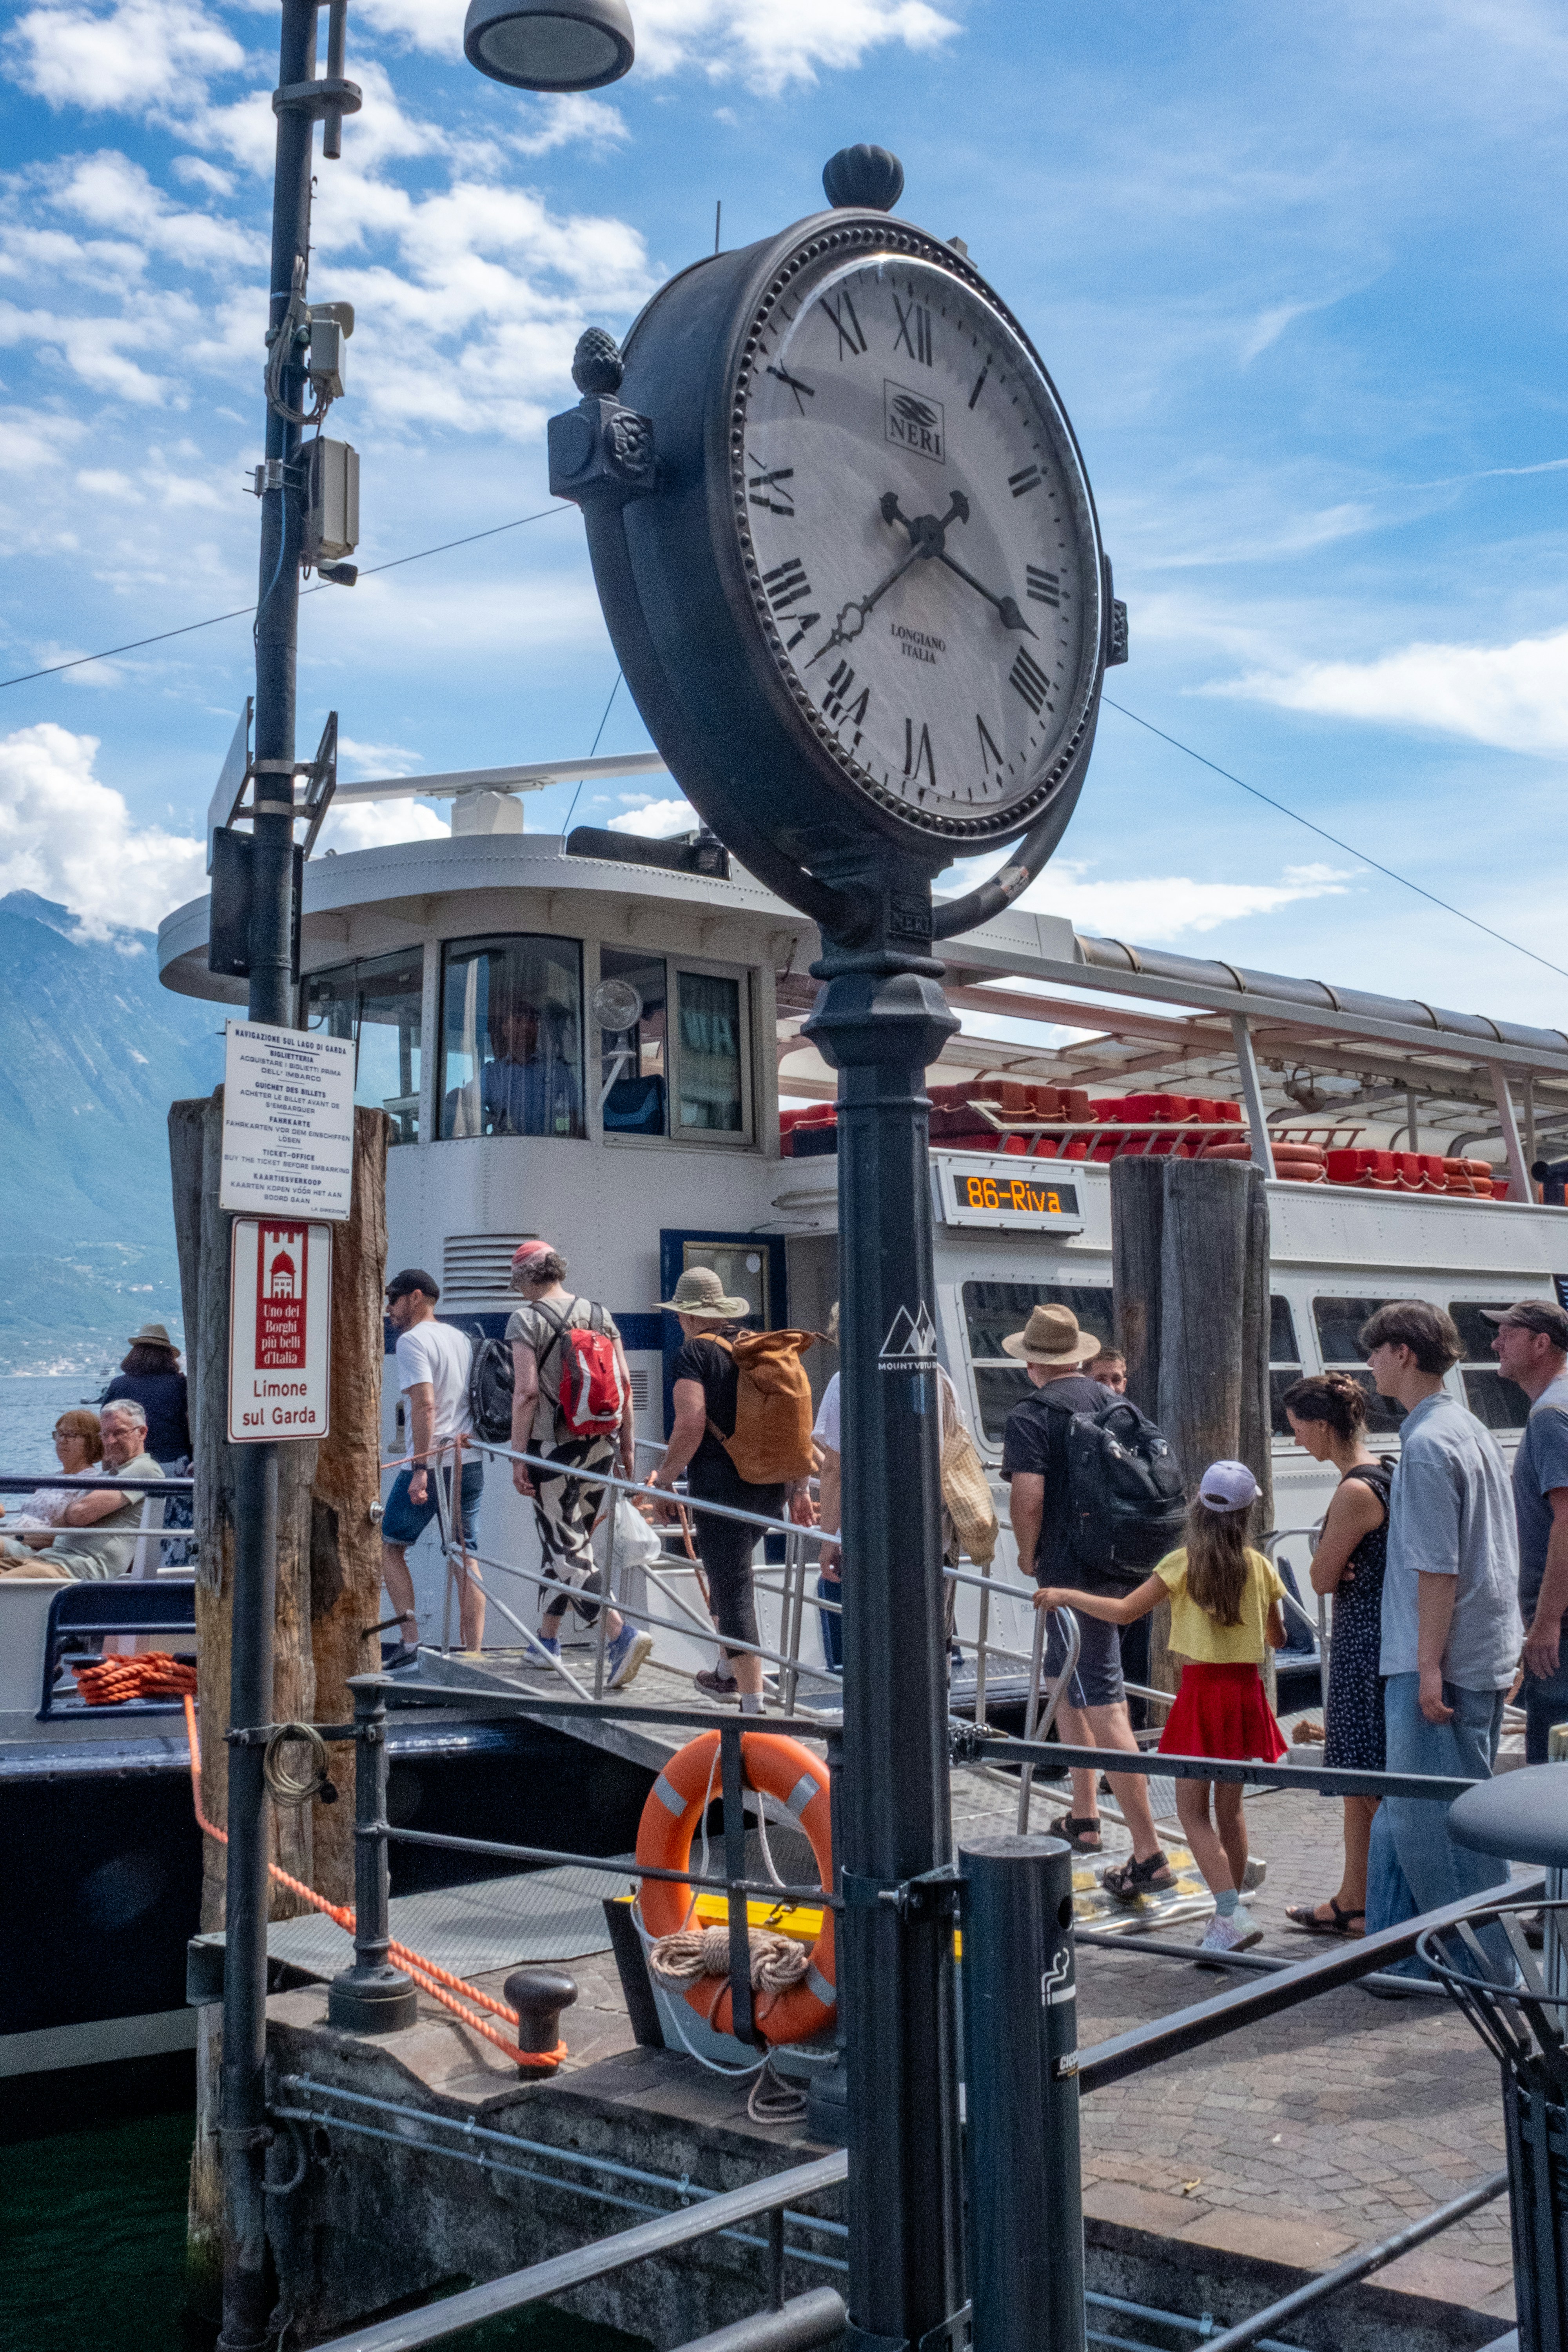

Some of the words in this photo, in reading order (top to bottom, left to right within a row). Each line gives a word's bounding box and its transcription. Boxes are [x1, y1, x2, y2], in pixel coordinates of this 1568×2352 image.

[889, 415, 941, 455] NERI
[891, 623, 946, 652] LONGIANO
[902, 643, 936, 664] ITALIA
[235, 1029, 280, 1044] NAVIGAZIONE
[298, 1040, 314, 1049] LAGO
[325, 1045, 347, 1054] GARDA
[240, 1055, 283, 1067] ACQUISTARE
[289, 1063, 319, 1073] BIGLIETTI
[270, 1050, 314, 1063] BIGLIETTERIA
[286, 1072, 321, 1082] IMBARCO
[240, 1089, 272, 1098] ACHETER
[284, 1096, 305, 1104] BILLET
[255, 1082, 283, 1091] GUICHET
[301, 1089, 326, 1098] BILLETS
[269, 1116, 310, 1127] FAHRKARTE
[226, 1120, 273, 1131] FAHRKARTEN
[309, 1131, 350, 1142] EINSCHIFFEN
[278, 1135, 301, 1143] LÖSEN
[262, 1149, 315, 1161] TICKET-OFFICE
[311, 1165, 350, 1174] EMBARKING
[230, 1181, 265, 1190] KAARTEN
[967, 1177, 1062, 1213] 86-Riva
[263, 1304, 282, 1318] Uno
[285, 1305, 299, 1318] dei
[265, 1320, 297, 1336] Borghi
[261, 1336, 277, 1351] più
[279, 1335, 300, 1349] belli
[263, 1351, 298, 1365] d'Italia
[253, 1379, 307, 1397] Limone
[243, 1408, 265, 1426] sul
[272, 1406, 316, 1425] Garda
